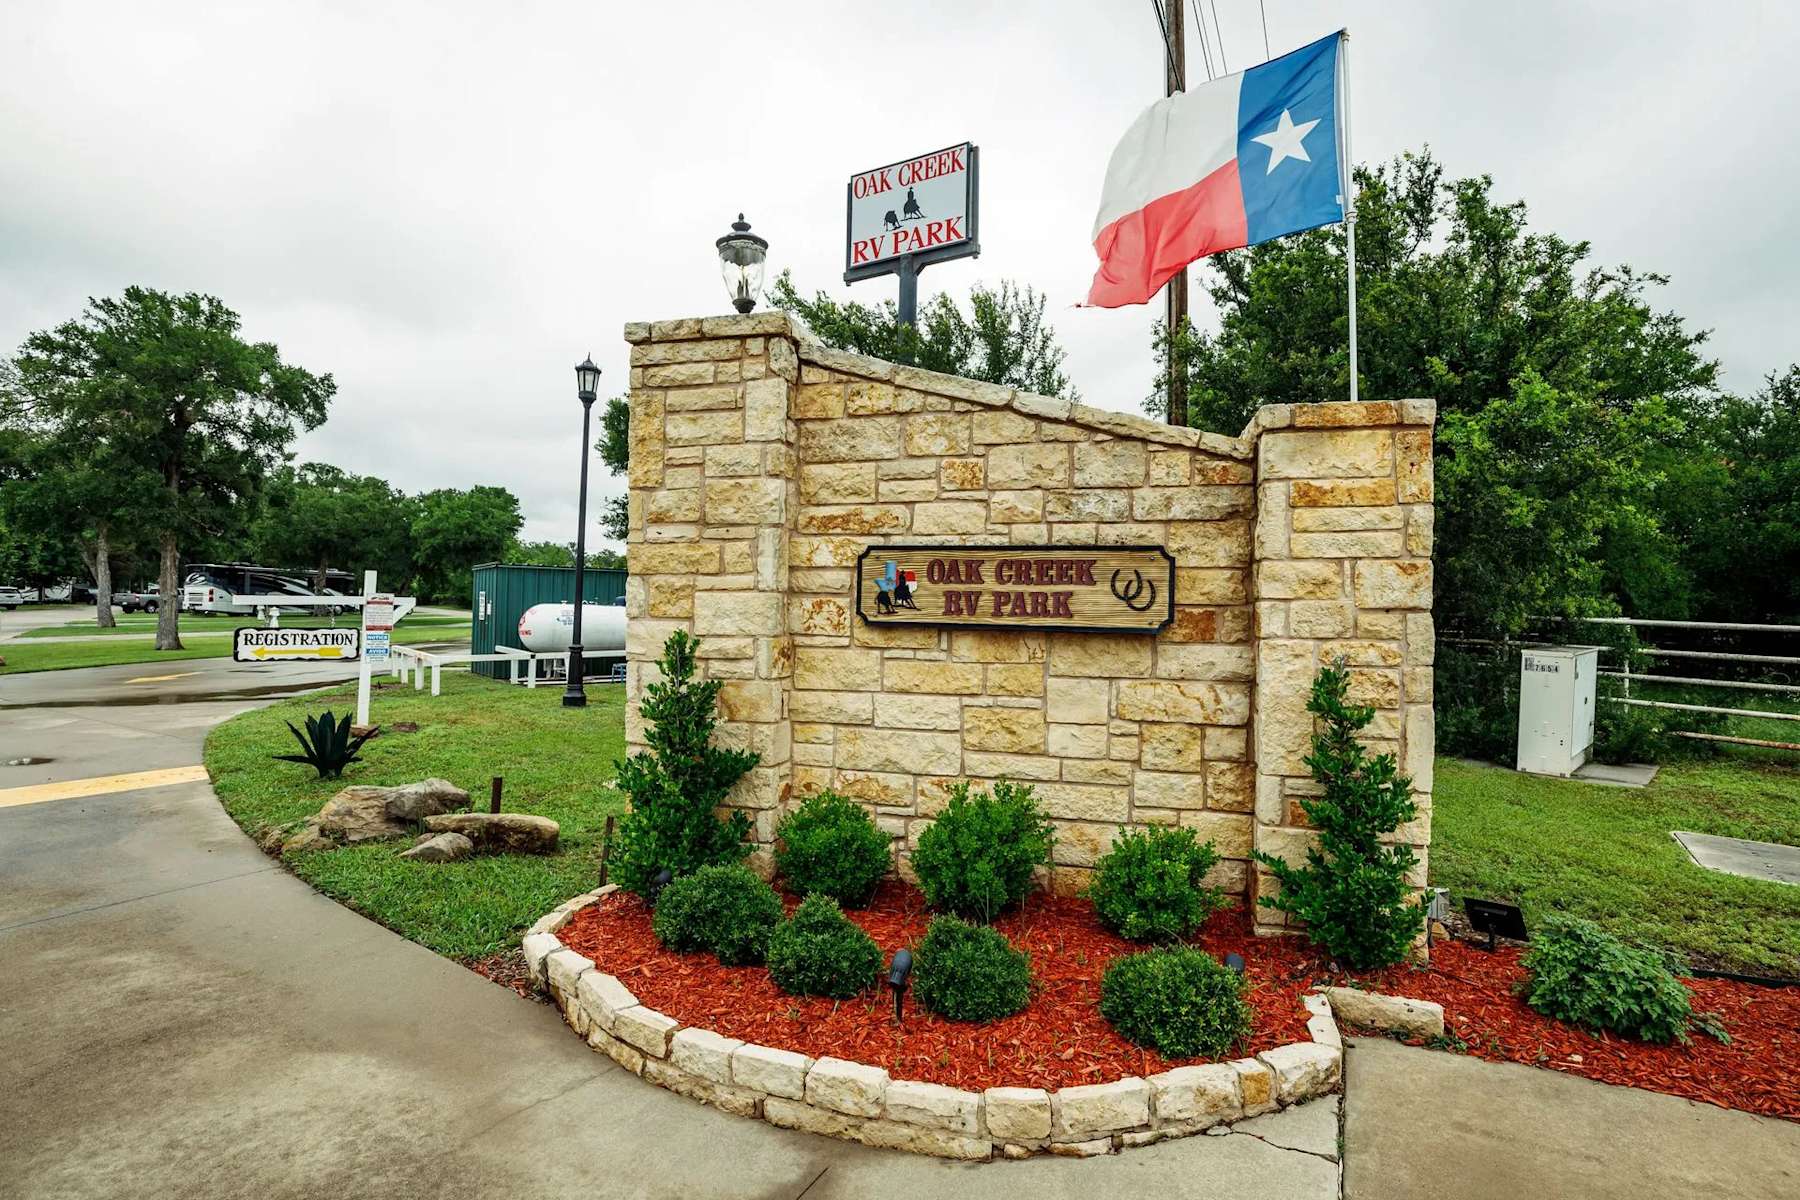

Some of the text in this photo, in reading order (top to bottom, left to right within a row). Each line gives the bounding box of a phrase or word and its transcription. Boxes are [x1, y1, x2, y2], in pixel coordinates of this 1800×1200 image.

[853, 147, 965, 200] OAK CREEK
[852, 216, 964, 264] RV PARK
[926, 559, 1097, 586] OAK CREEK
[942, 591, 1073, 619] RV PARK
[244, 633, 353, 646] REGISTRATION
